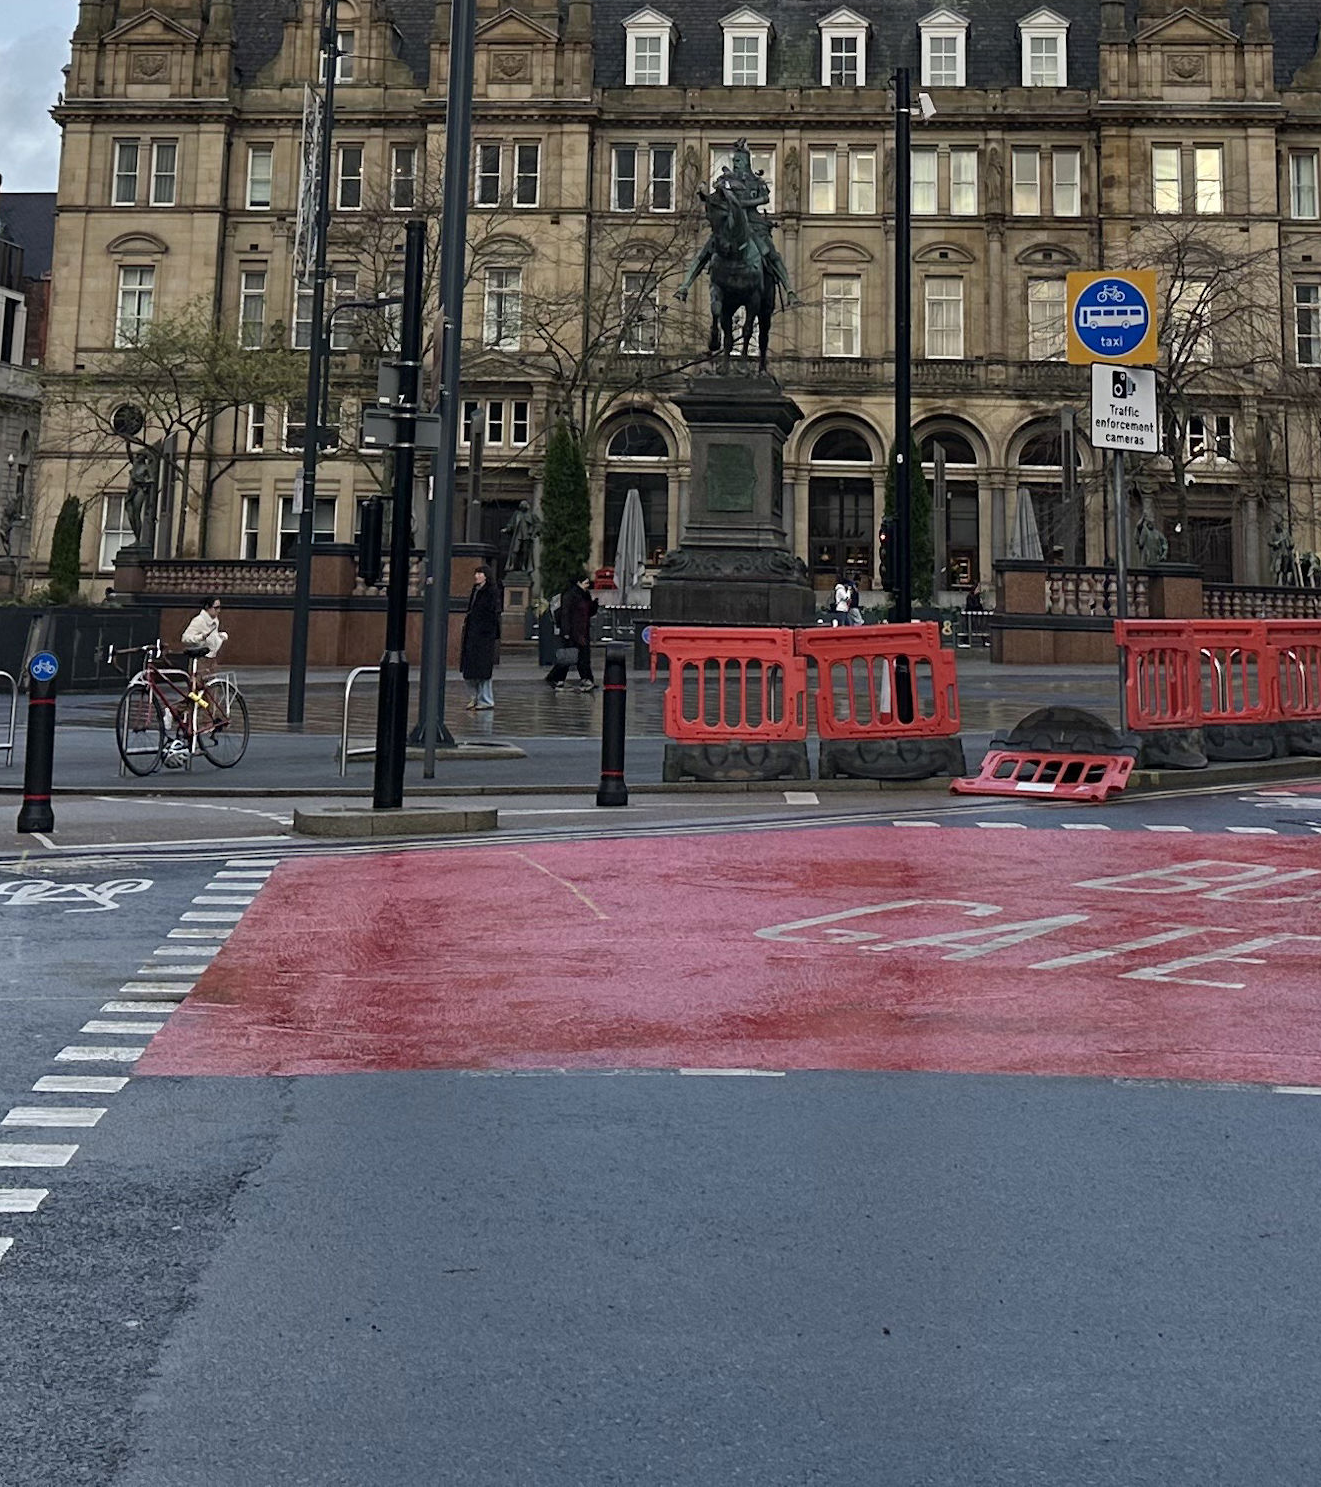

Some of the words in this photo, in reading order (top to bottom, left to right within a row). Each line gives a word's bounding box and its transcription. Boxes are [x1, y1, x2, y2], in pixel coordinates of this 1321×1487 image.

[1100, 335, 1124, 347] taxi
[398, 394, 405, 405] 7
[1109, 404, 1140, 418] Traffic
[1095, 417, 1154, 433] enforcement
[1105, 433, 1144, 446] cameras
